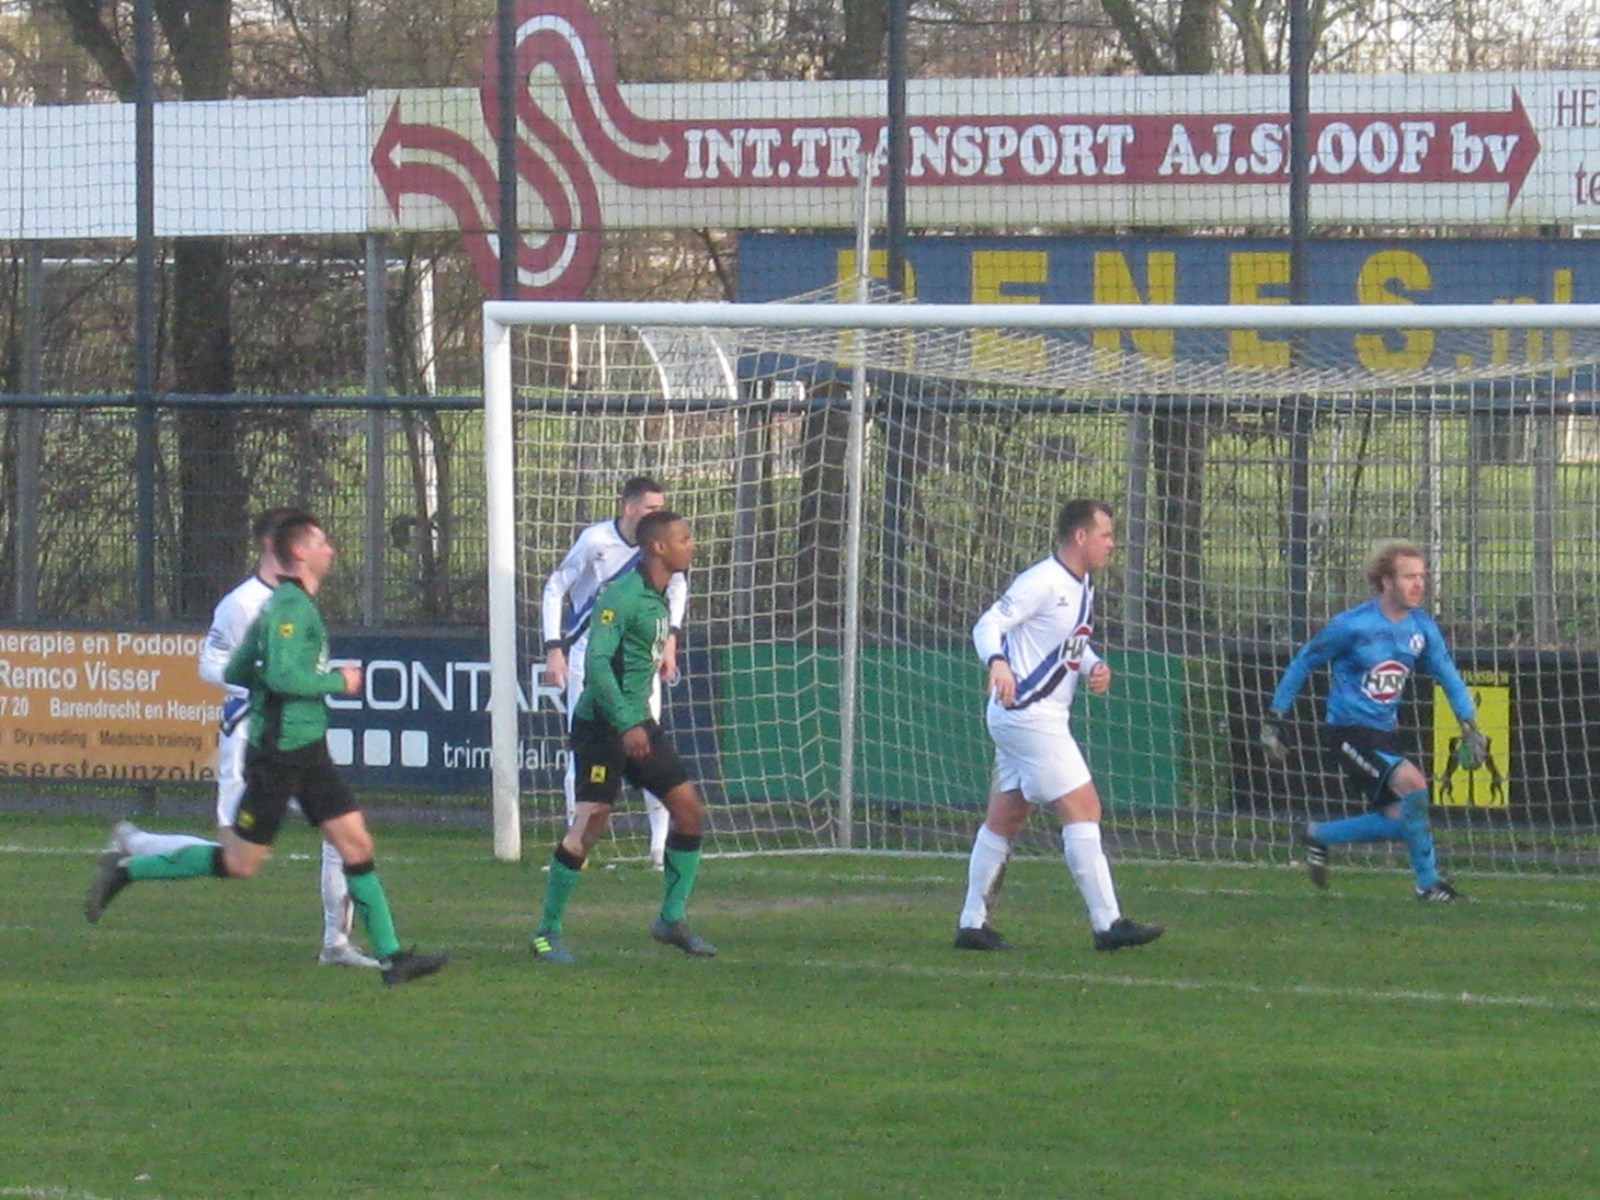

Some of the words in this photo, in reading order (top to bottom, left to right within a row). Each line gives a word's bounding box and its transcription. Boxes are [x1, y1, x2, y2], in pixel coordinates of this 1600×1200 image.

[1557, 89, 1600, 127] HE
[1450, 121, 1520, 173] bv
[83, 635, 109, 653] en
[0, 659, 77, 690] Remco
[84, 661, 161, 691] Visser
[12, 695, 29, 717] 20
[50, 697, 141, 720] Barendrecht
[145, 703, 163, 720] en
